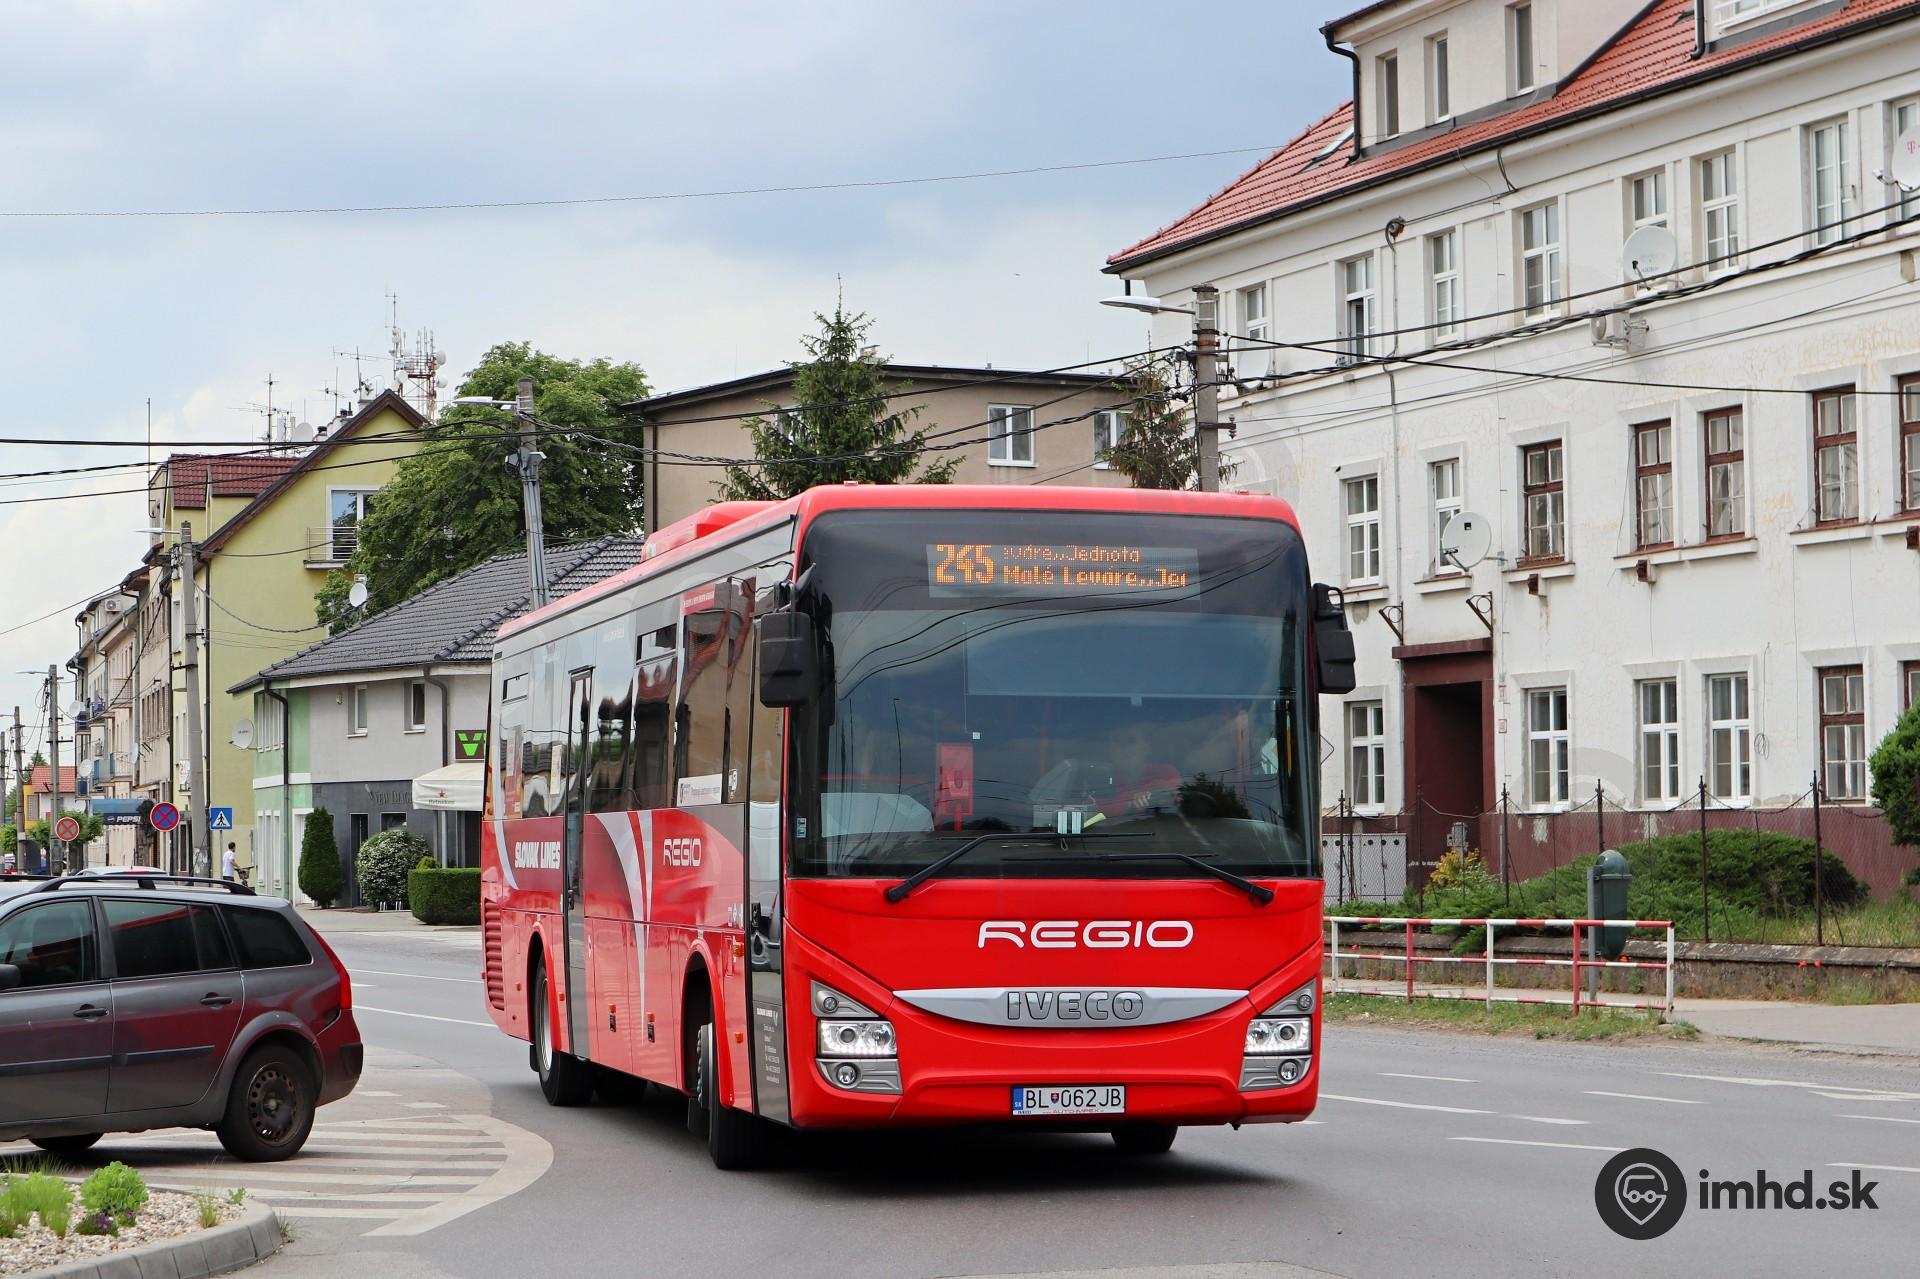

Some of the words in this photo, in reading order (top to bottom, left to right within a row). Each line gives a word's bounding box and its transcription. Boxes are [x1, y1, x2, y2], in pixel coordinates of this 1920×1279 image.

[936, 544, 993, 583] 245
[1003, 564, 1053, 584] Malé
[116, 815, 141, 823] PEPSI
[514, 841, 539, 868] SLOVAK
[540, 841, 560, 869] LINES
[663, 838, 702, 867] REGIO
[978, 920, 1193, 948] REGIO
[1007, 991, 1144, 1020] IVECO
